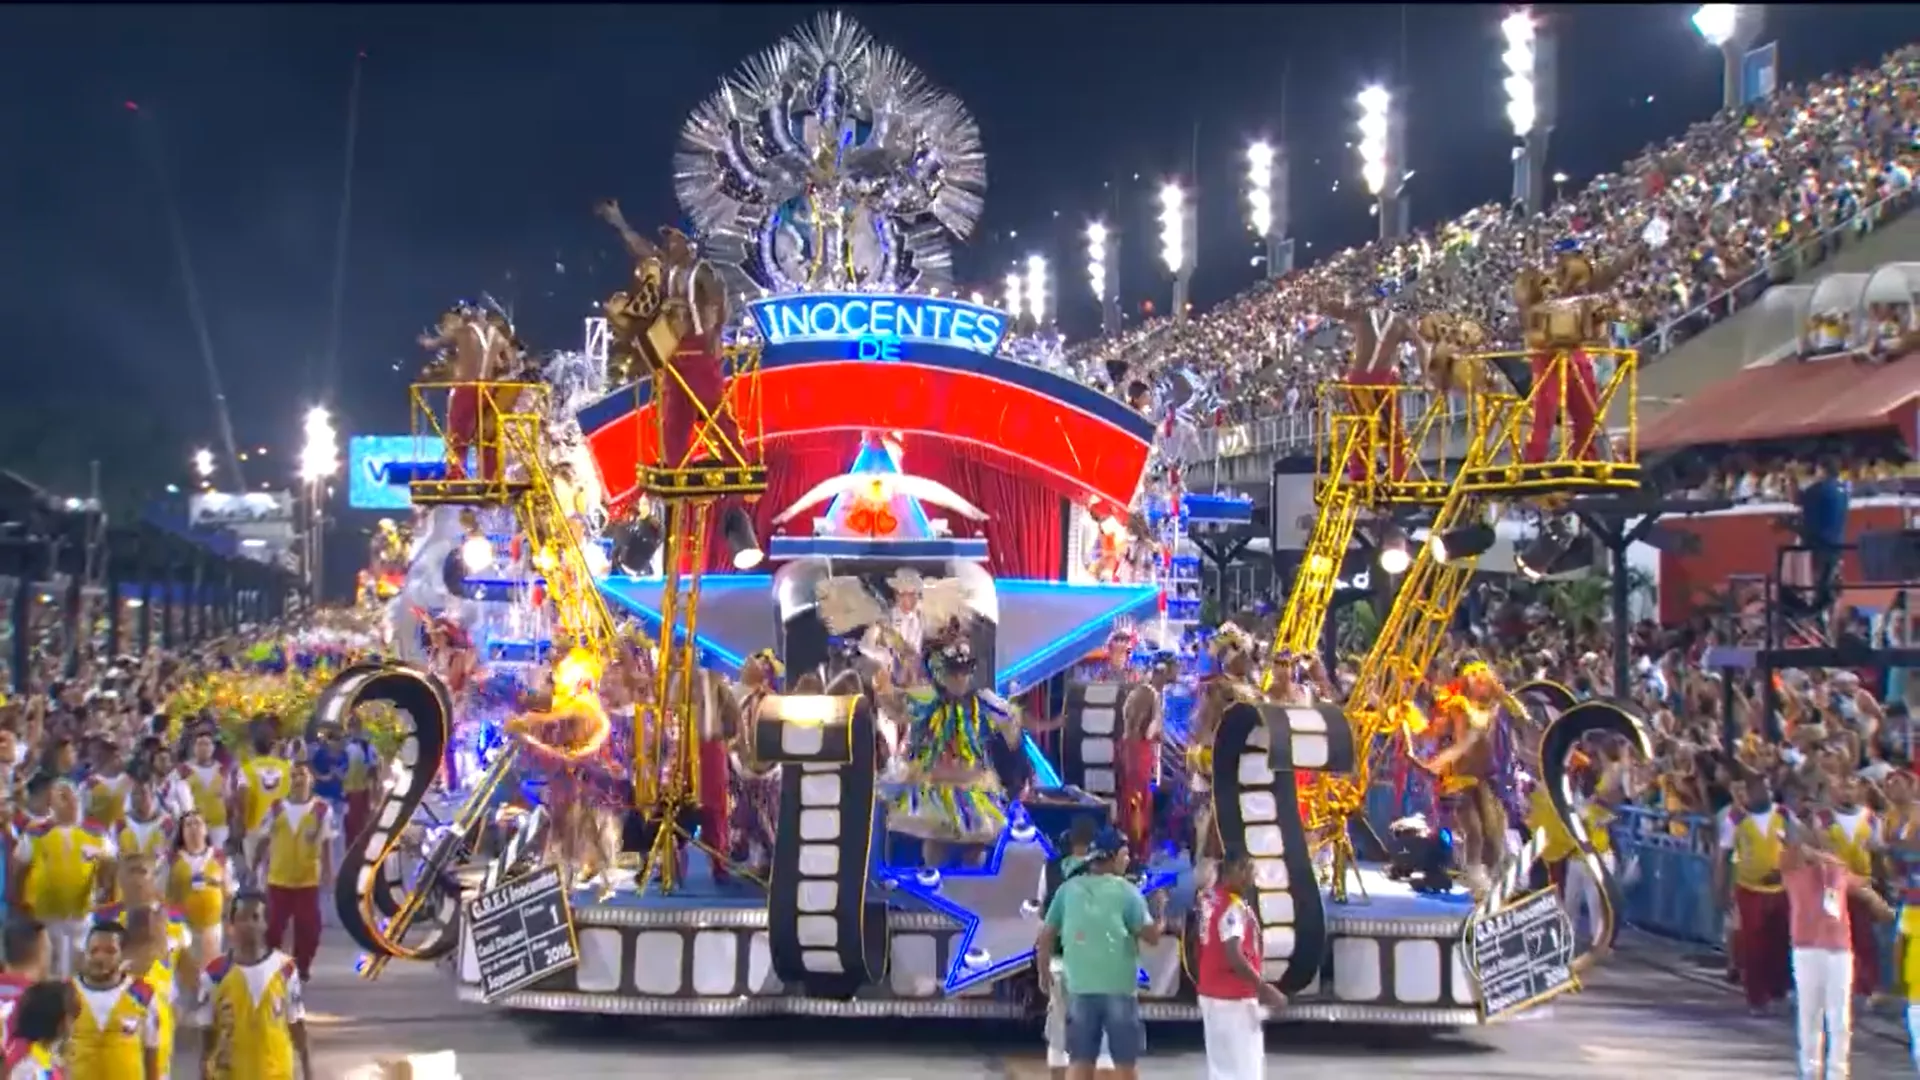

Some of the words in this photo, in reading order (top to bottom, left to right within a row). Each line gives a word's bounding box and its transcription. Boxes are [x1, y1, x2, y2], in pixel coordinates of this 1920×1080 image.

[763, 300, 1001, 350] INOCENTES
[857, 335, 900, 361] DE
[550, 904, 559, 925] 1
[543, 941, 573, 965] 2016
